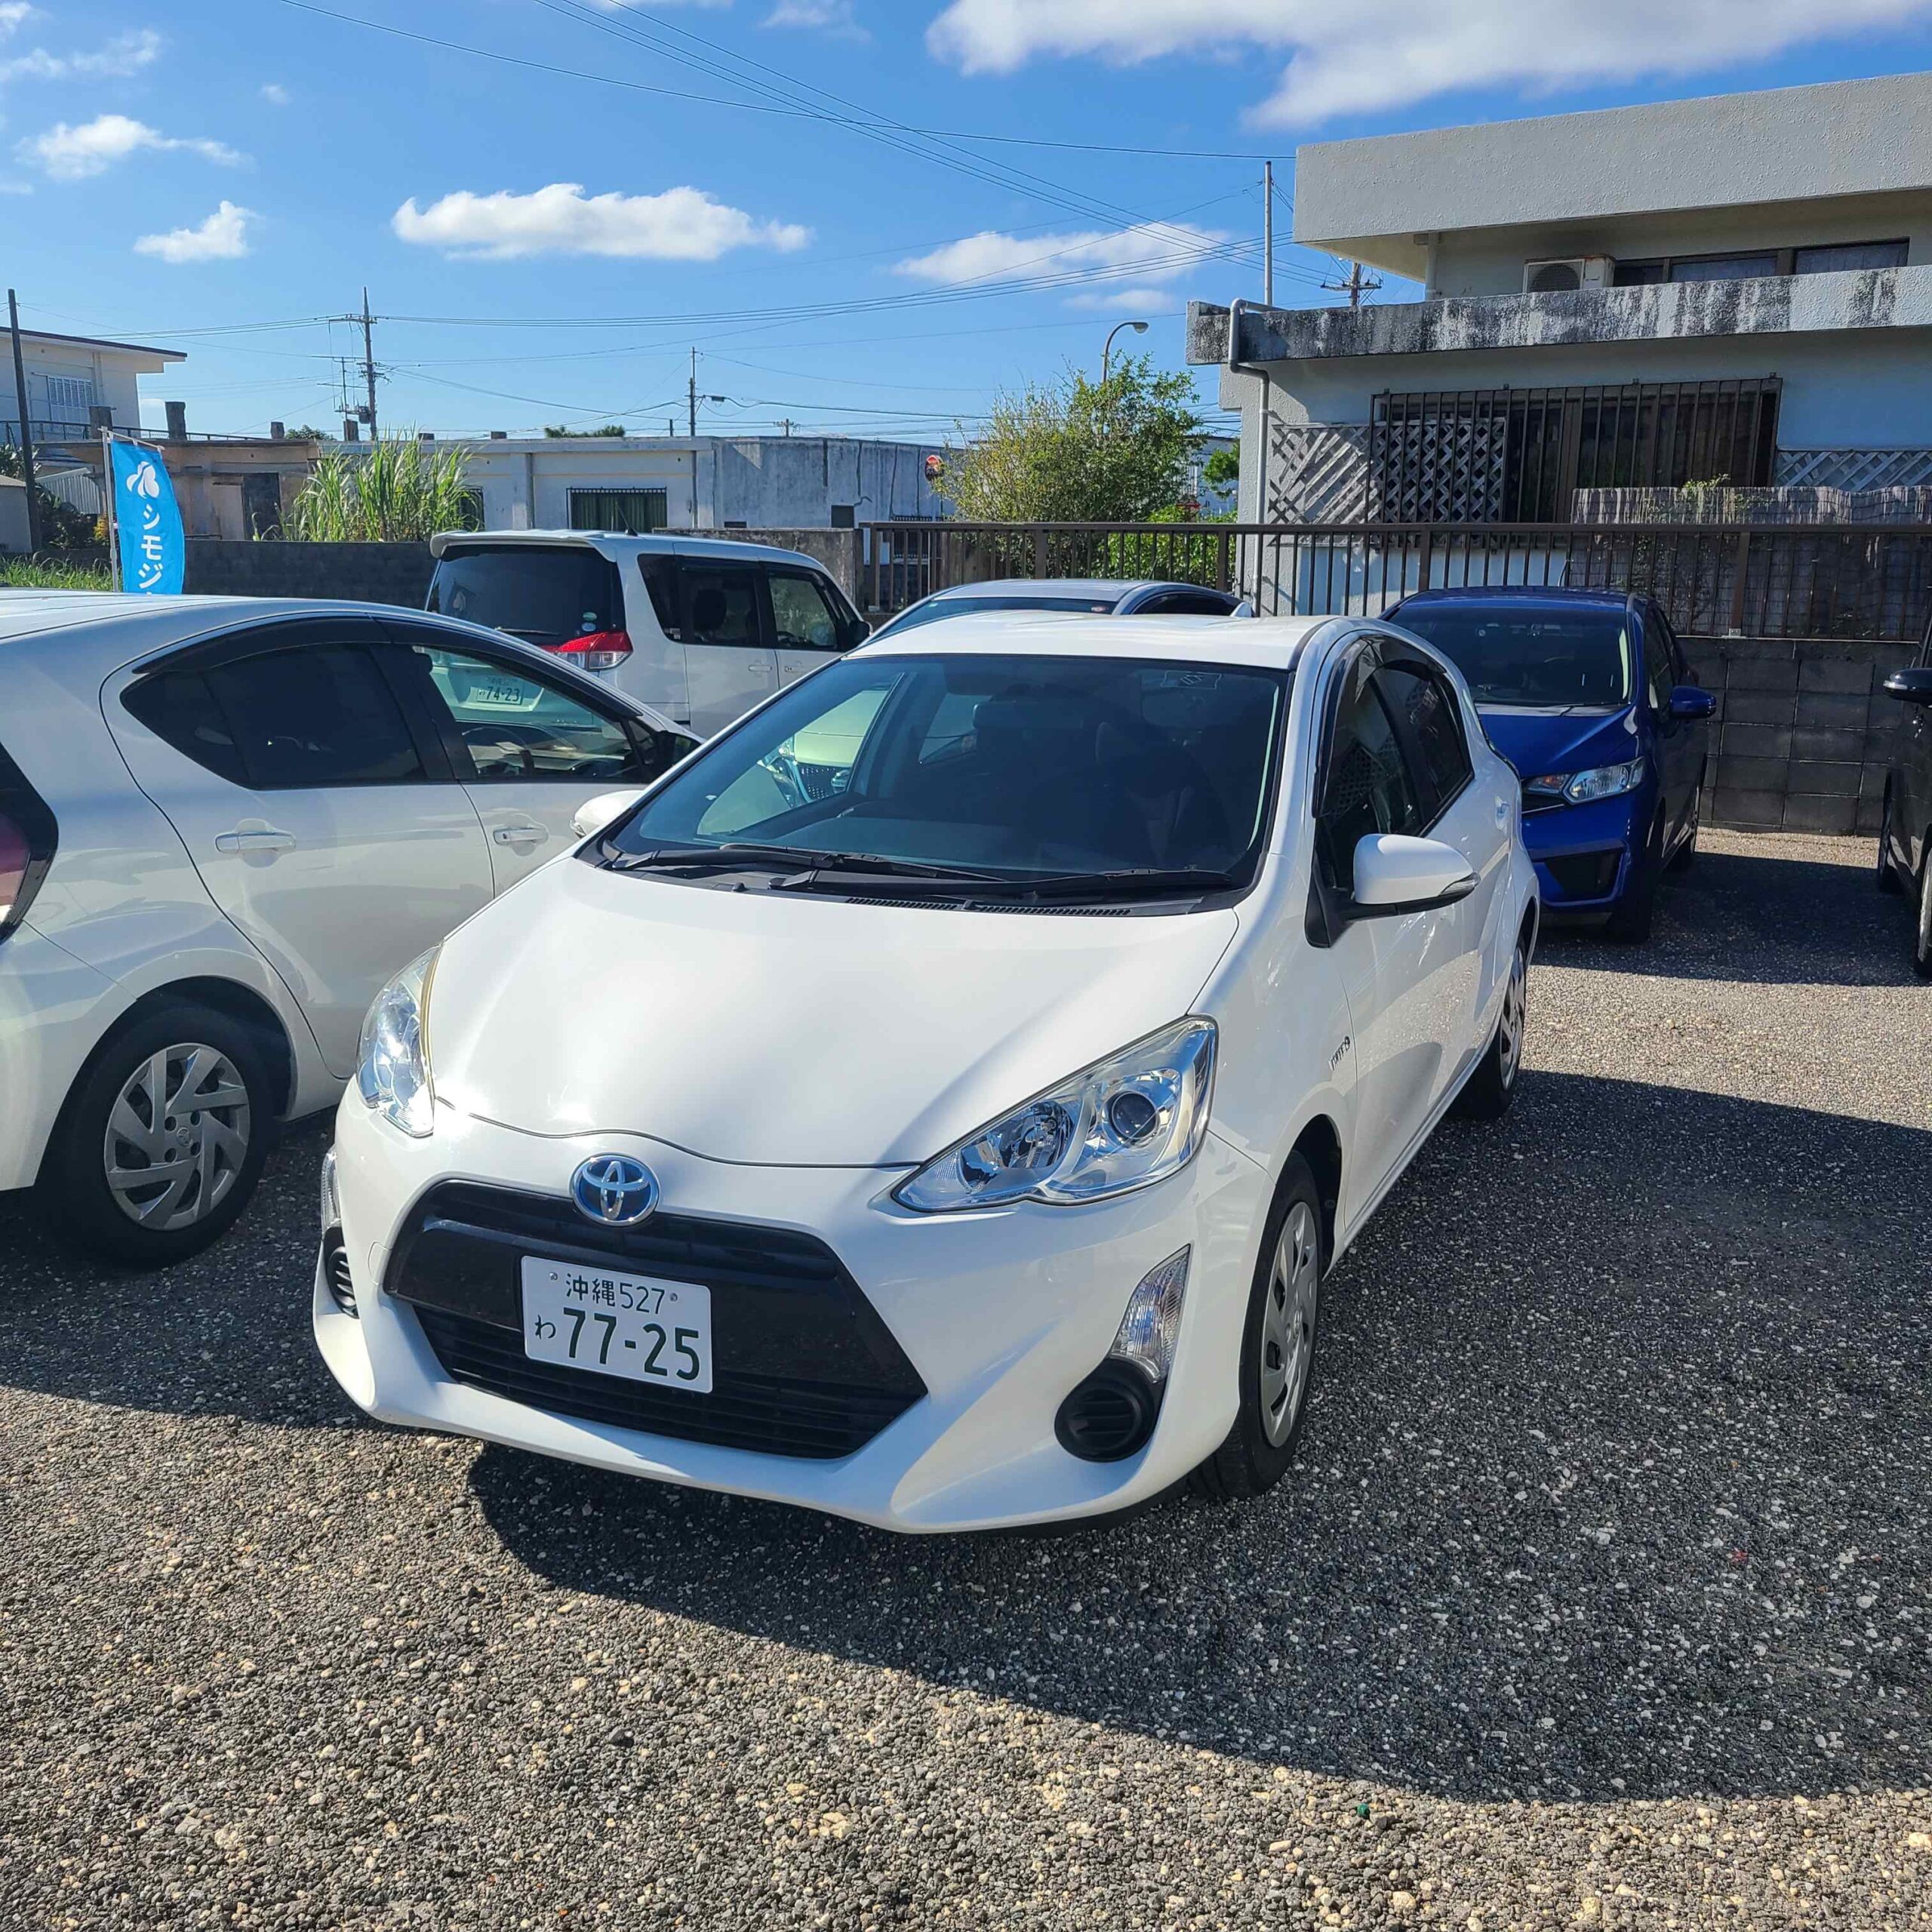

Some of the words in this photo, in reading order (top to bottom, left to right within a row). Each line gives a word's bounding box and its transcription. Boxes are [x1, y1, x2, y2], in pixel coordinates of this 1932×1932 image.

[139, 503, 163, 594] シモジ
[486, 686, 520, 702] 74-23
[534, 1314, 557, 1340] わ
[563, 1306, 700, 1380] 77-25
